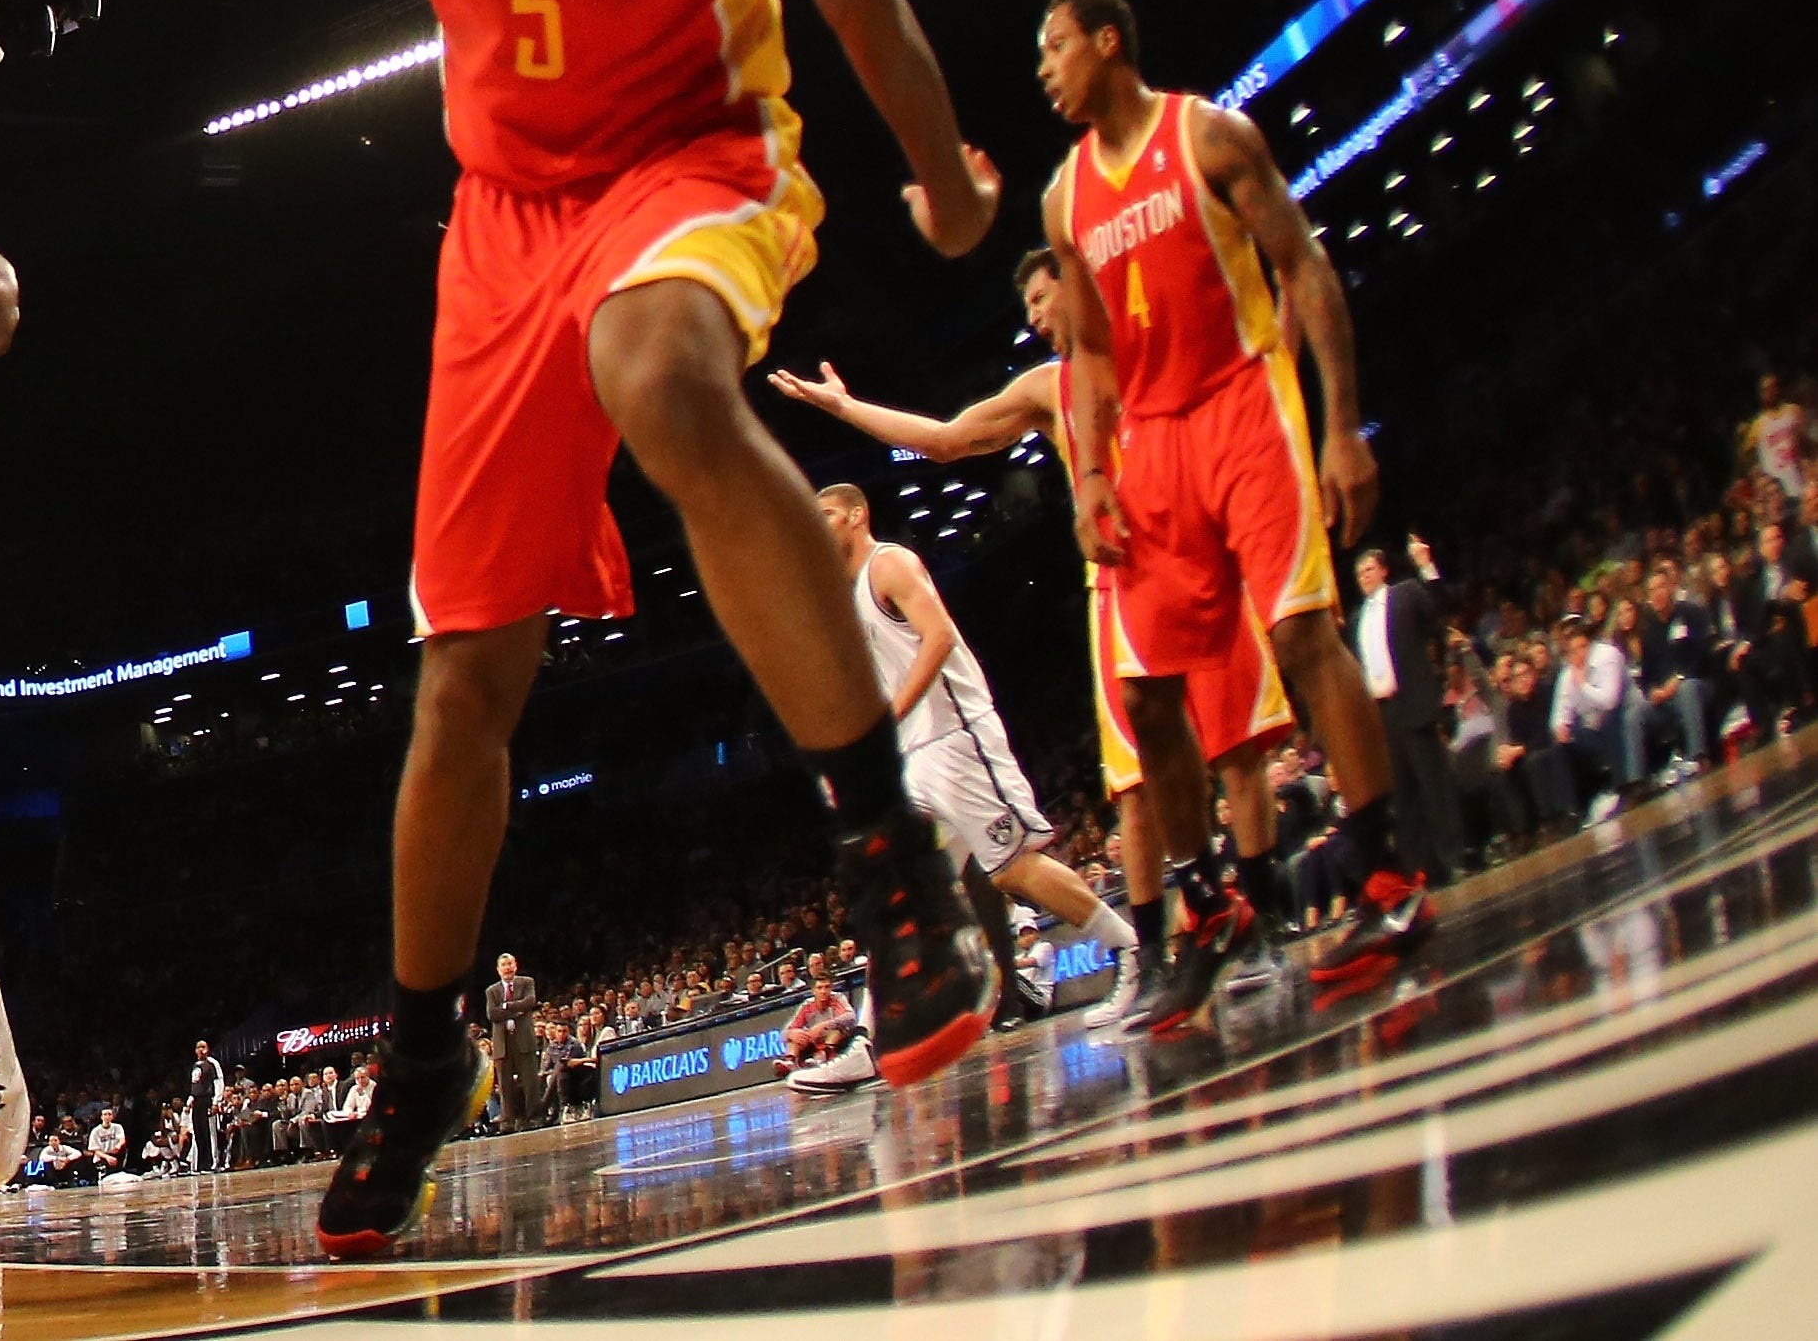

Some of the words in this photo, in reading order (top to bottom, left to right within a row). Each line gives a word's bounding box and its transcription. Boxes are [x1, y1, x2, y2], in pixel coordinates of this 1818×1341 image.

[1082, 180, 1185, 275] HOUSTON
[1125, 260, 1153, 330] 4
[20, 670, 114, 697] Investment
[117, 641, 226, 682] Management
[631, 1046, 711, 1088] BARCLAYS
